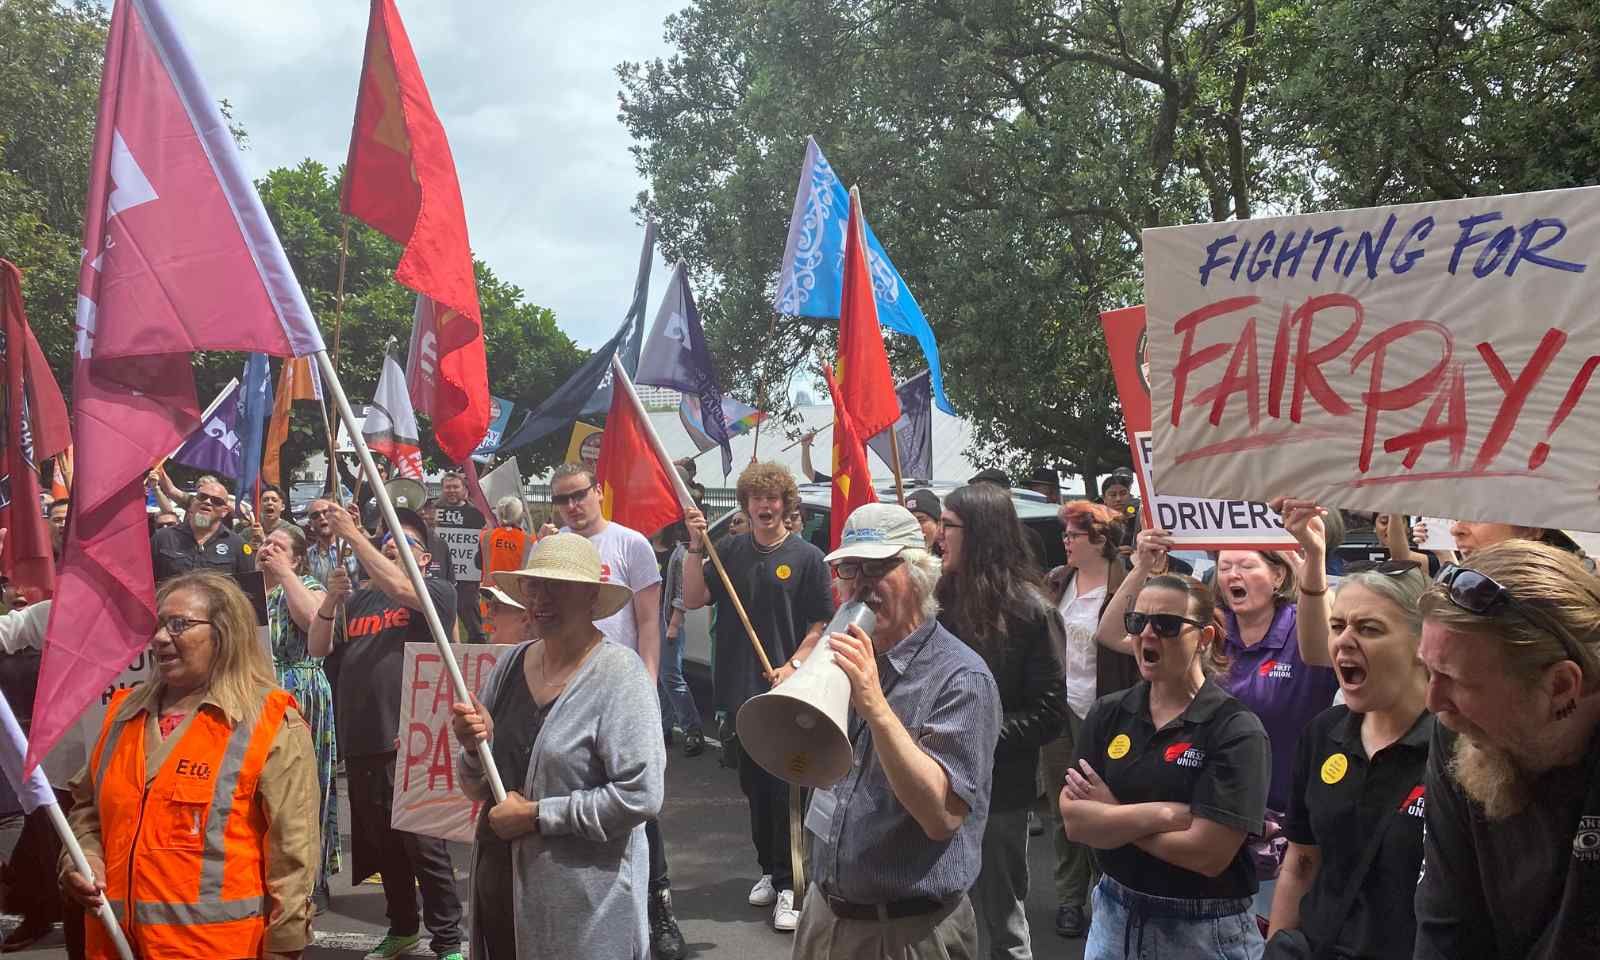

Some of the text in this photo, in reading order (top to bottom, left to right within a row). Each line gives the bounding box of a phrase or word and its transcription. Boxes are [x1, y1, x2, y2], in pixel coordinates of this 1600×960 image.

[1200, 211, 1587, 287] FIGHTING FOR
[1171, 292, 1364, 431] FAIR
[1350, 320, 1600, 474] PAY!
